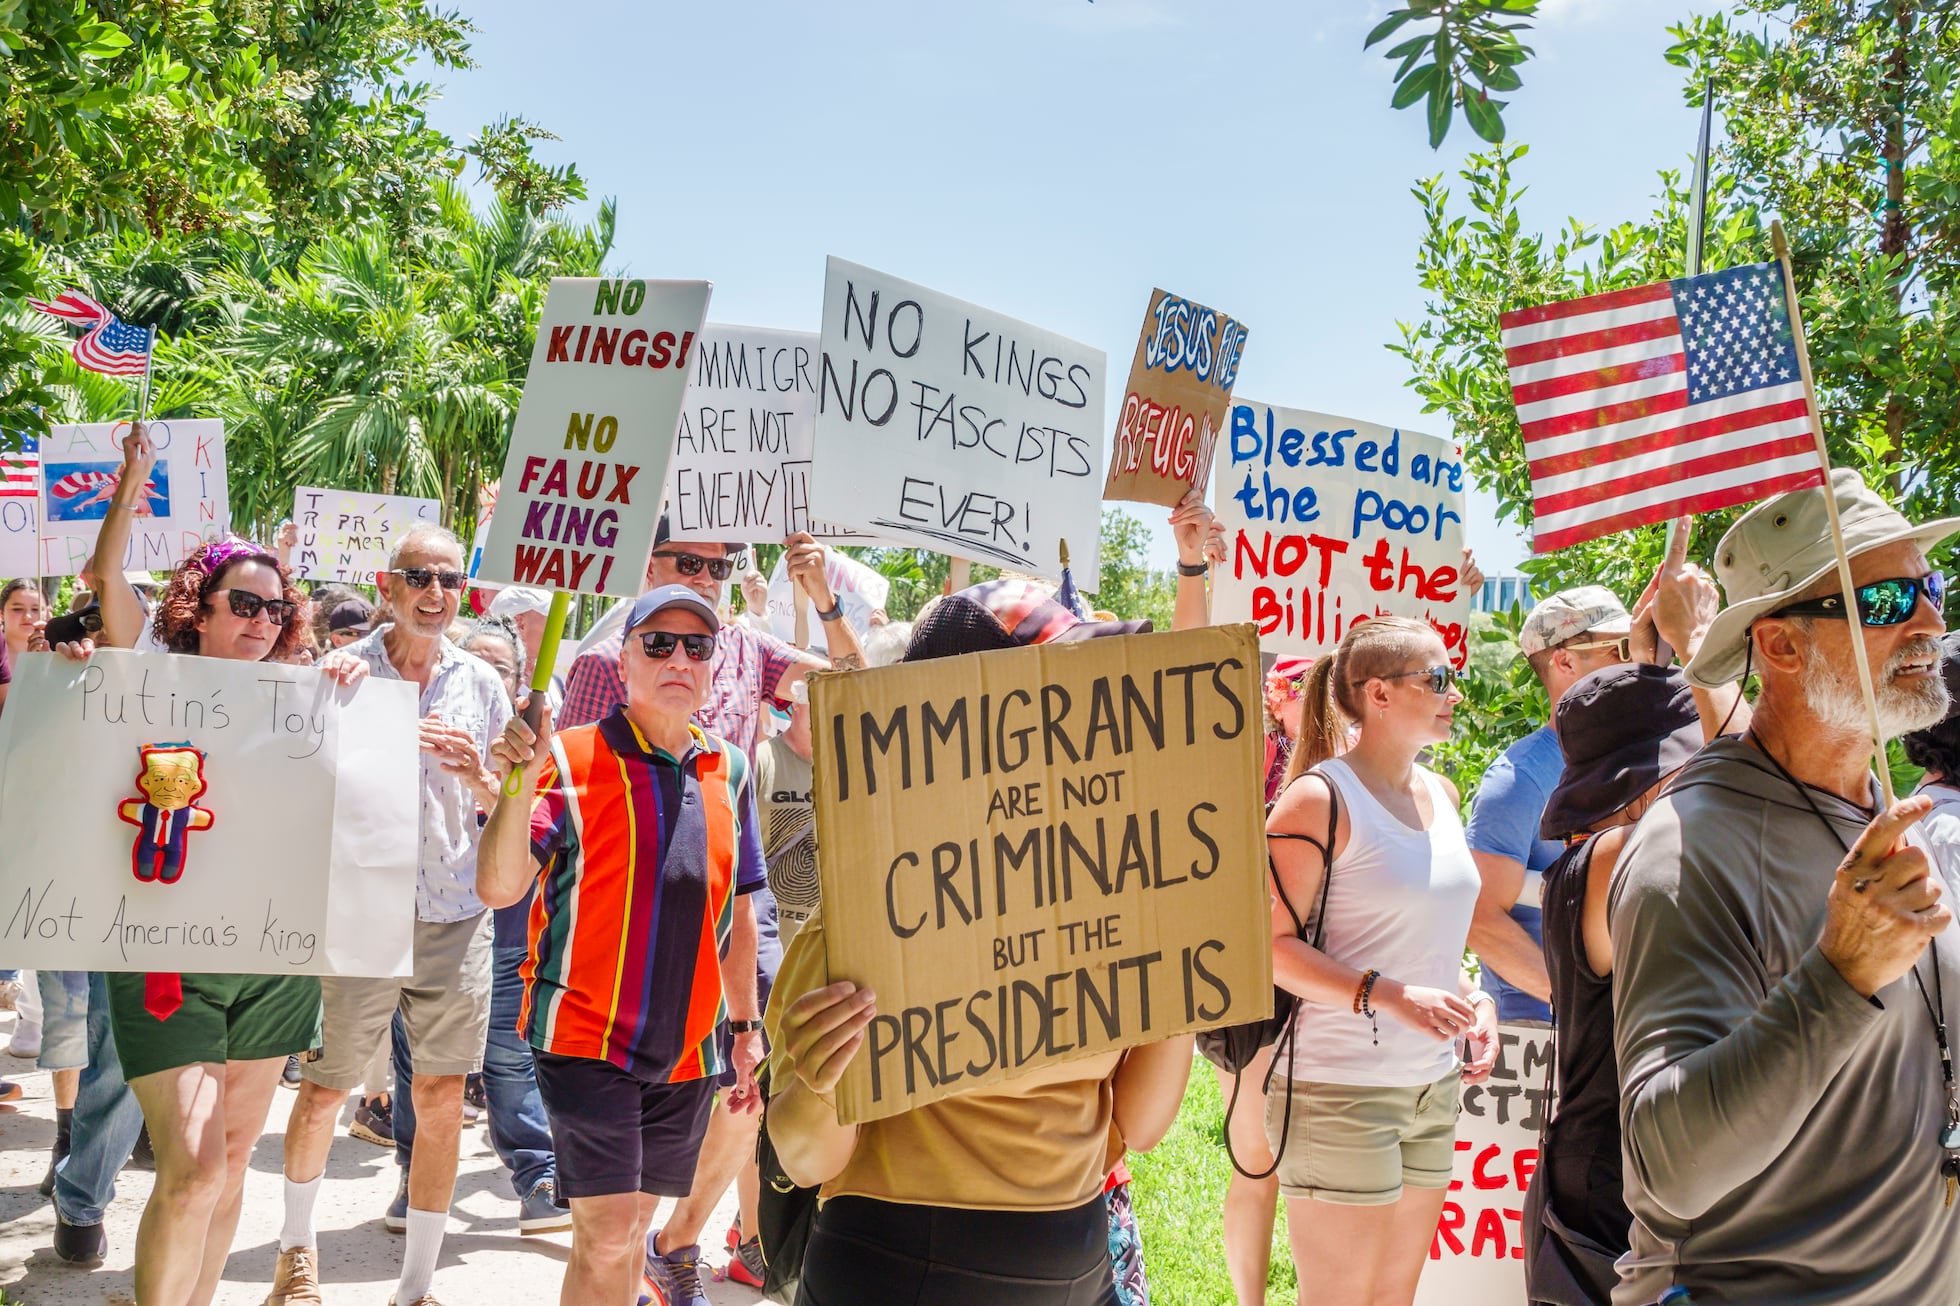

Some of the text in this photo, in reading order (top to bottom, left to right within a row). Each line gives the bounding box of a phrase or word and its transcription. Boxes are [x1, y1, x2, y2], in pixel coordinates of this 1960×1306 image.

[594, 280, 646, 316] NO
[546, 326, 695, 369] KINGS!
[698, 341, 816, 394] MMIGR
[845, 280, 1090, 408] NO KINGS
[1146, 293, 1216, 382] JESUS
[564, 413, 619, 454] NO
[677, 407, 794, 455] ARE NOT
[820, 353, 1091, 477] NO FASCISTS
[1231, 404, 1464, 492] Blessed are
[518, 456, 640, 505] FAUX
[678, 469, 777, 530] ENEMY.
[899, 476, 1030, 552] EVER!
[1233, 471, 1461, 541] the poor
[521, 501, 619, 548] KING
[513, 544, 615, 593] WAY!
[1234, 529, 1458, 603] NOT the
[80, 665, 325, 759] Putin's Toy
[833, 657, 1245, 802] IMMIGRANTS
[986, 770, 1126, 824] ARE NOT
[885, 801, 1220, 939] CRIMINALS
[4, 879, 83, 942] Not
[102, 894, 238, 962] America's
[993, 914, 1122, 971] BUT THE
[868, 939, 1232, 1103] PRESIDENT IS
